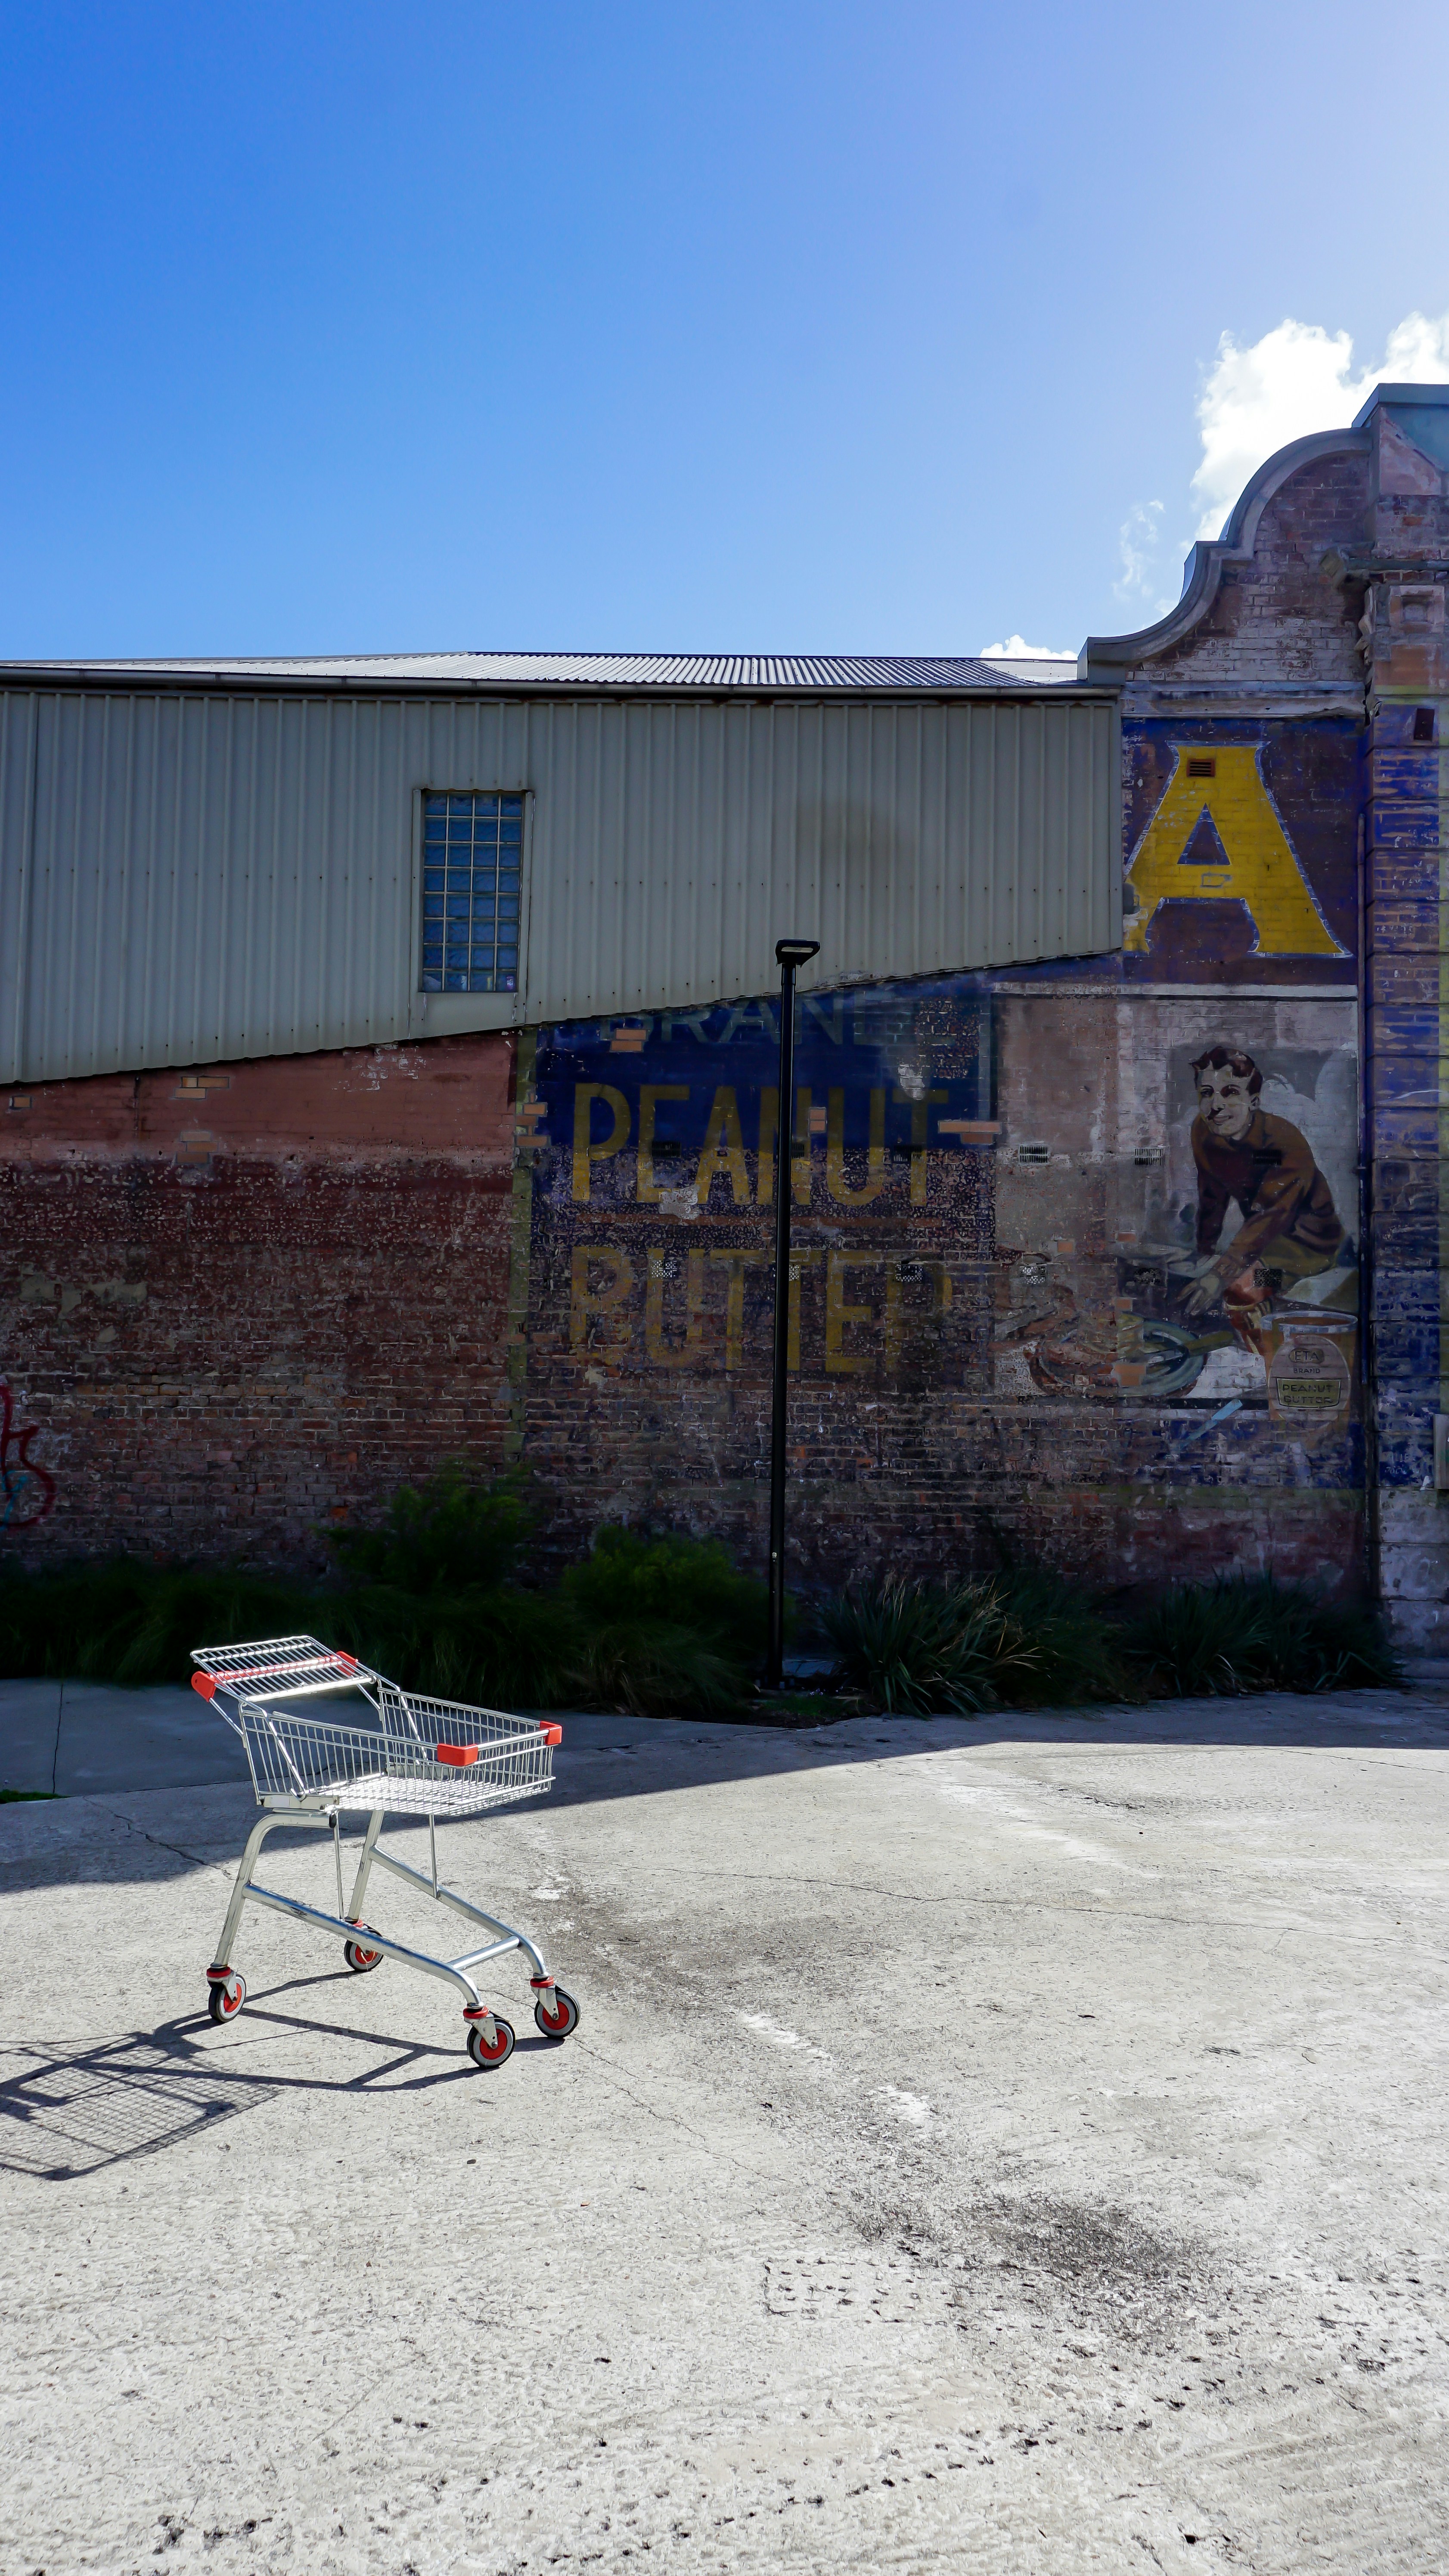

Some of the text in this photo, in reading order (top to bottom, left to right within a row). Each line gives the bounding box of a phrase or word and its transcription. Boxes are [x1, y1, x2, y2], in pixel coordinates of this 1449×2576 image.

[1122, 741, 1352, 957] A
[572, 1082, 948, 1206] PEANUT
[1283, 1384, 1332, 1392] PEANUT
[1295, 1351, 1319, 1360] ETA
